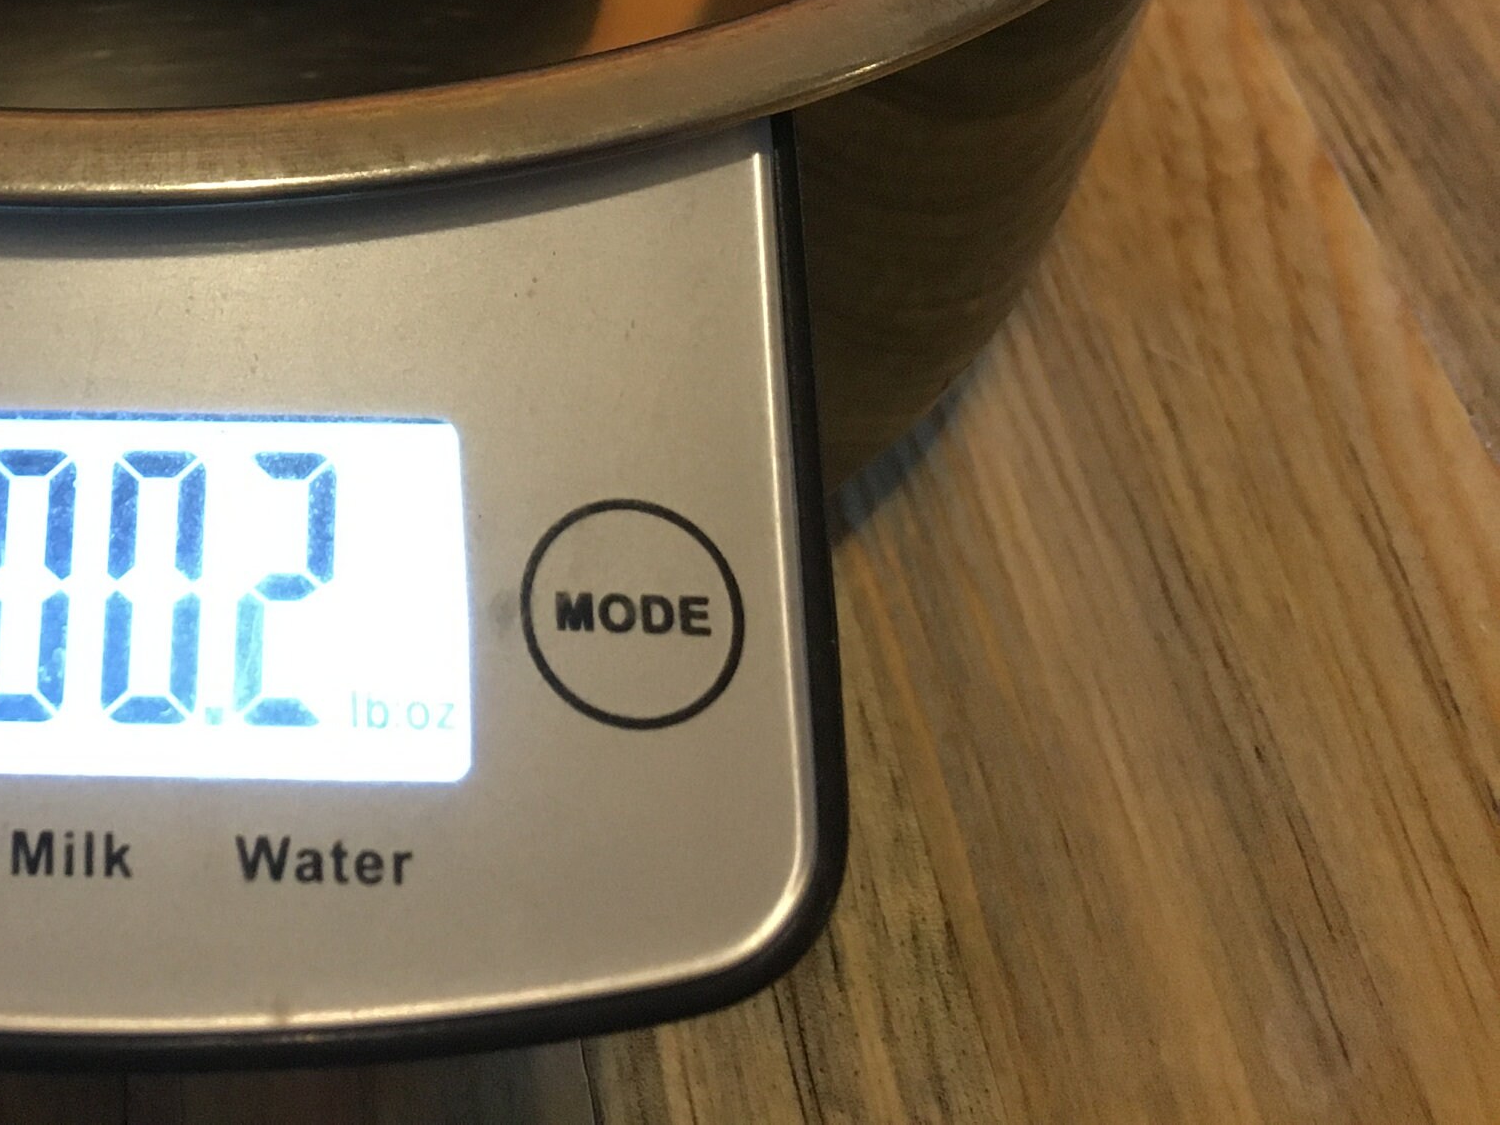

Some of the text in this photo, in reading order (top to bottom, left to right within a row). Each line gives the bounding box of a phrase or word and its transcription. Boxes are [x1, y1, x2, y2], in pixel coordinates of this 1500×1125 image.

[555, 591, 712, 636] MODE
[10, 831, 133, 879] Milk
[235, 836, 414, 886] Water
